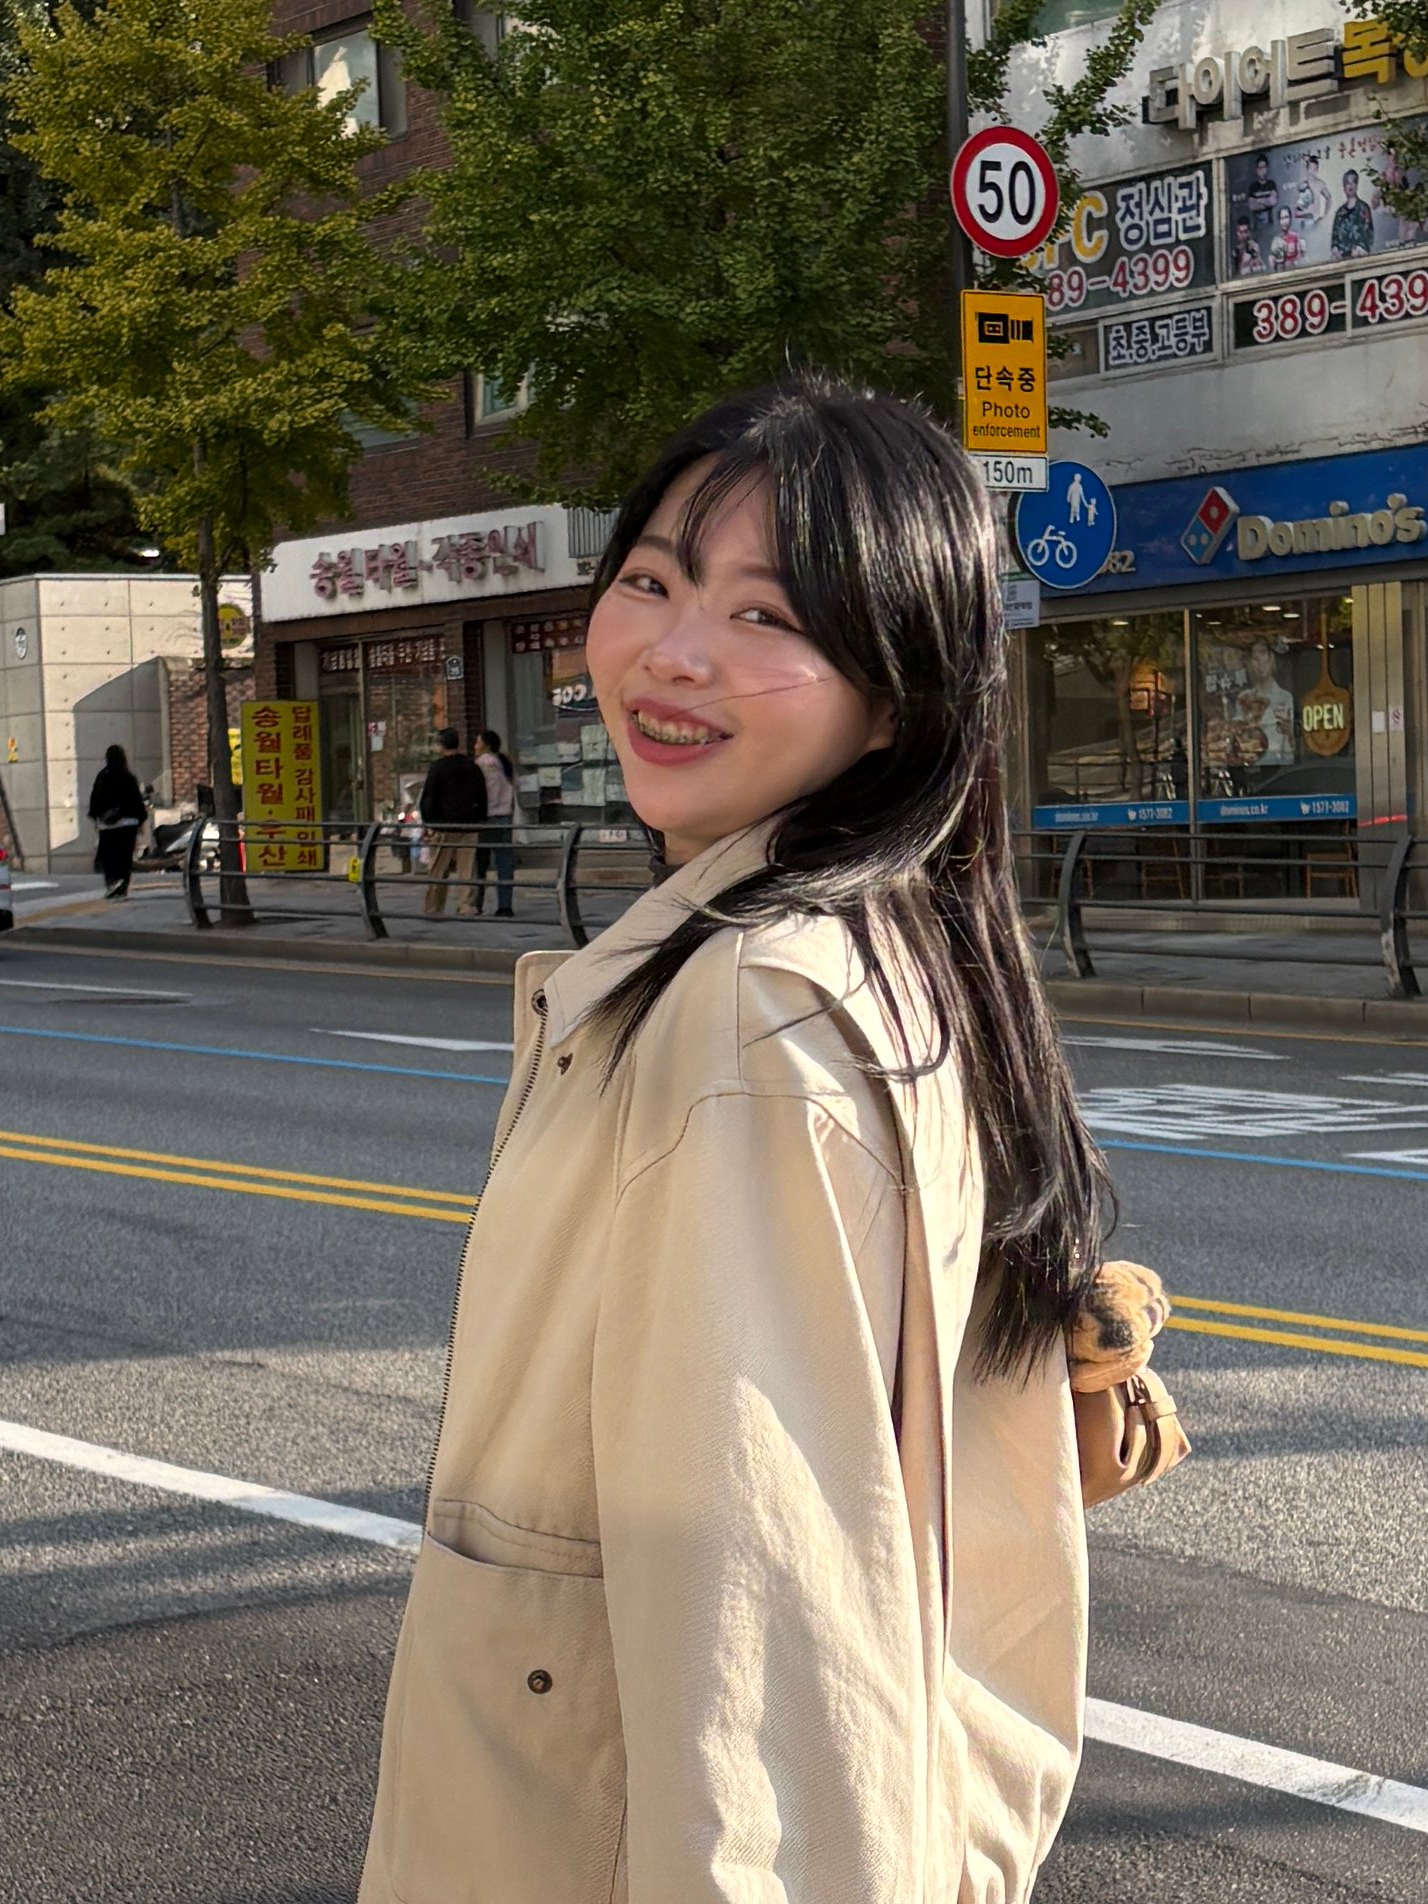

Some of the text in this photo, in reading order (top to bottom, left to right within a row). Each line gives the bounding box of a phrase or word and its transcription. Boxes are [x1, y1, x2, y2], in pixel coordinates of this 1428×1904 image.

[1147, 27, 1339, 130] 다이어트
[977, 159, 1037, 226] 50
[1115, 169, 1209, 252] 정심관
[1044, 244, 1195, 312] 89-4399
[974, 364, 1036, 394] 단속중
[972, 423, 1041, 439] enforcement
[981, 400, 1031, 420] Photo
[983, 460, 1034, 484] 150m
[1236, 492, 1428, 561] Domino's
[1302, 703, 1345, 732] OPEN
